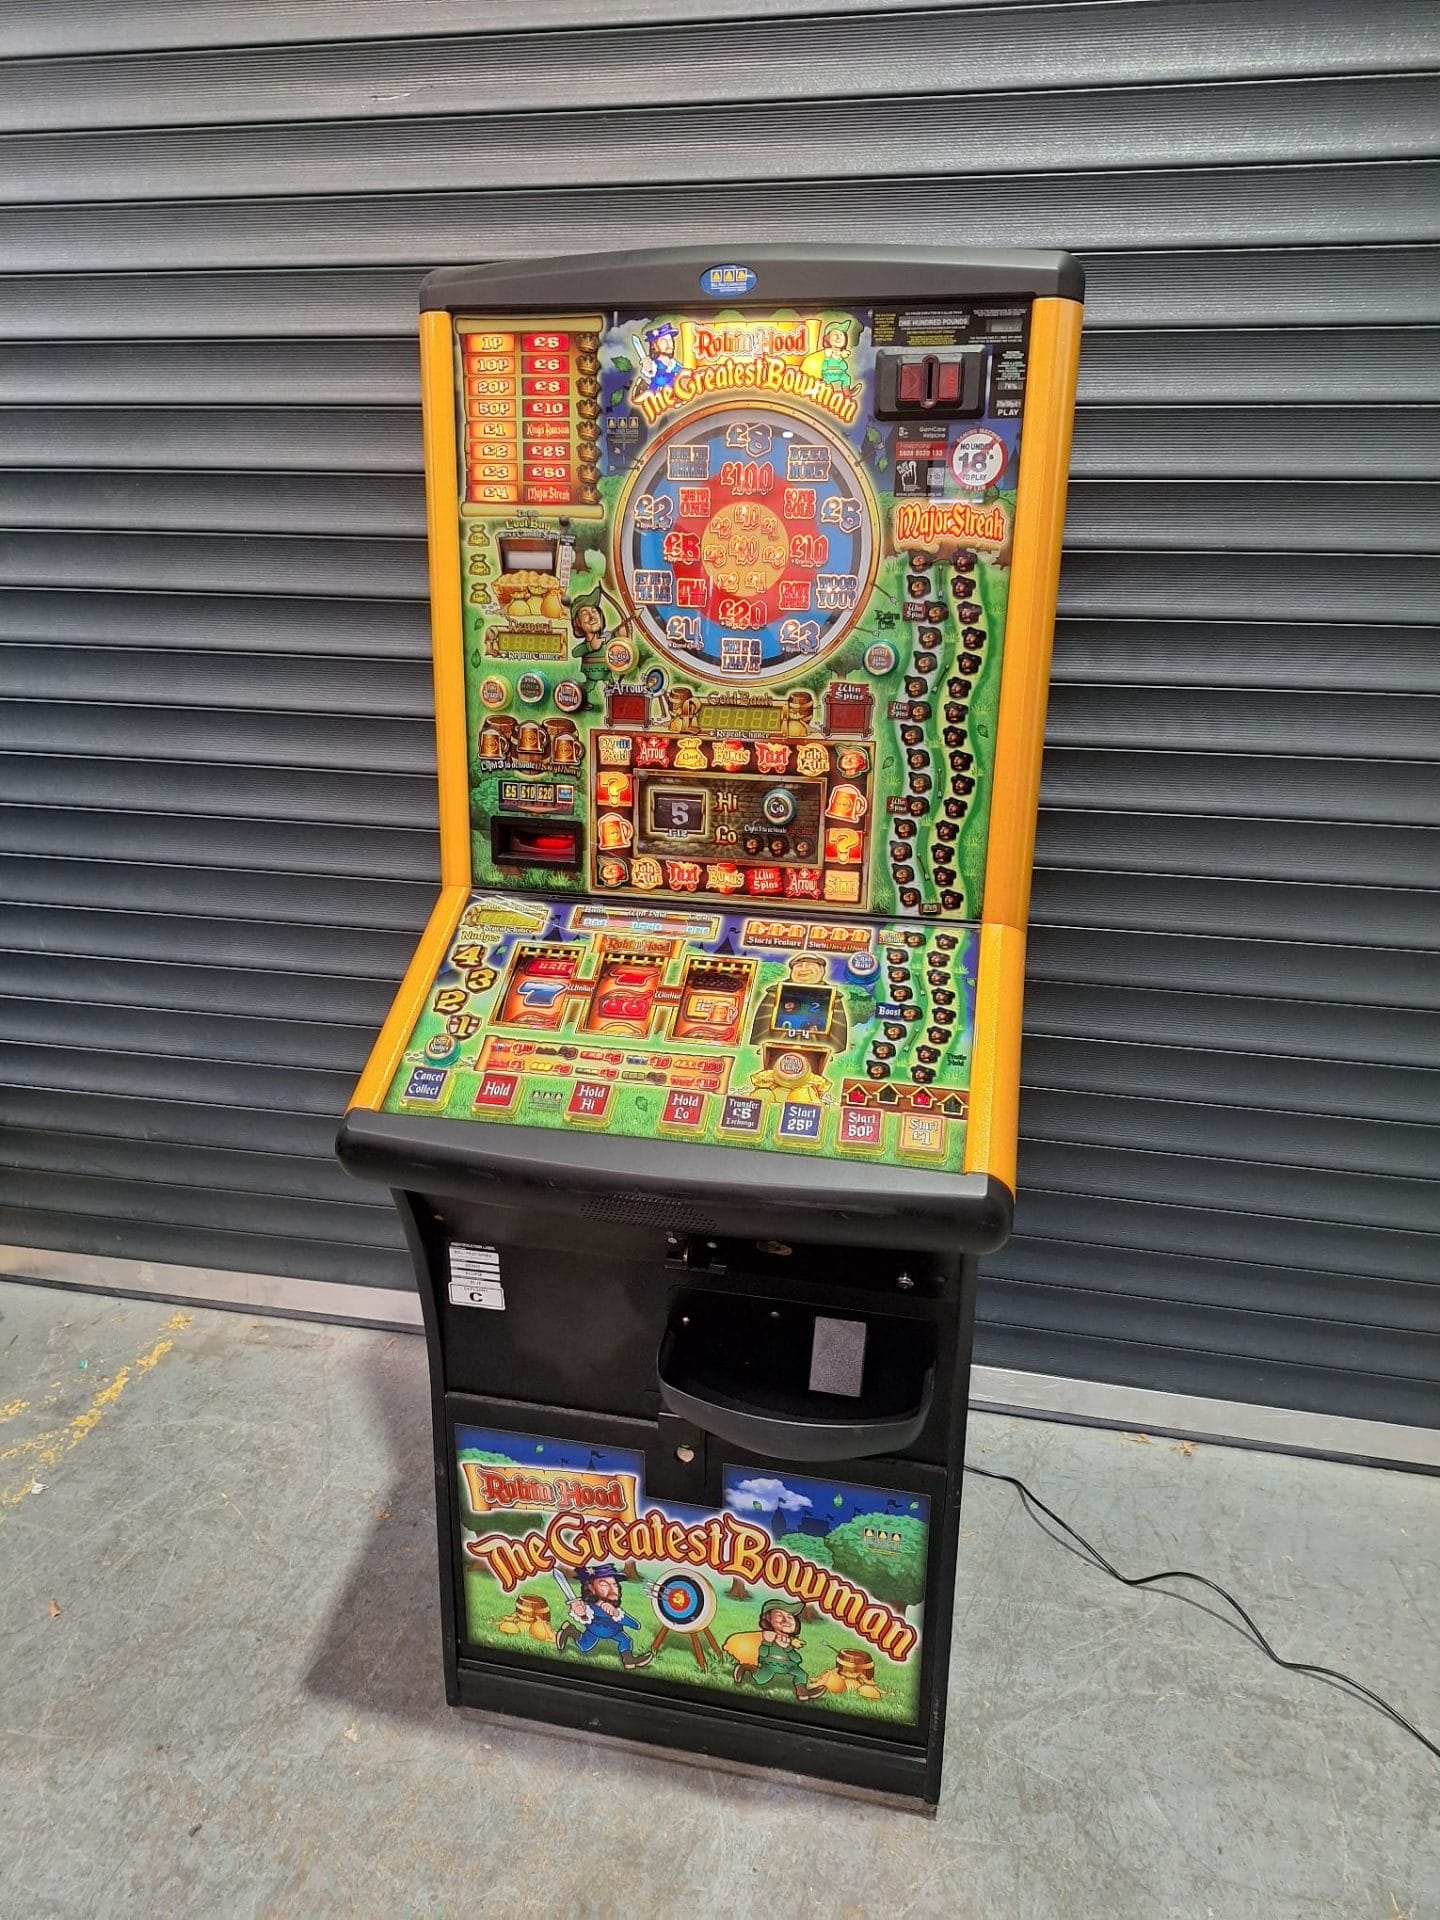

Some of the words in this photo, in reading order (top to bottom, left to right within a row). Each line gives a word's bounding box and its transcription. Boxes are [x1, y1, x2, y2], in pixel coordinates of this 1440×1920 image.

[695, 329, 748, 356] Robin
[751, 328, 806, 356] Hood
[631, 388, 673, 424] The
[674, 356, 765, 401] Greatest
[764, 355, 858, 423] Bowman
[532, 402, 563, 414] £10
[998, 408, 1019, 416] PLAY
[484, 423, 505, 436] £1
[727, 423, 772, 457] £8
[970, 442, 993, 450] UNDER
[483, 445, 508, 458] £2
[532, 446, 565, 457] £25
[483, 466, 508, 478] £3
[532, 467, 565, 478] £50
[721, 461, 774, 494] £100
[484, 486, 509, 500] £4
[634, 494, 673, 528] £2
[898, 504, 951, 543] Major
[951, 503, 1005, 542] Streak
[790, 534, 828, 567] £10
[719, 598, 767, 630] £20
[780, 619, 820, 654] £3
[611, 681, 648, 694] Arrows
[838, 684, 862, 693] Win
[835, 691, 864, 700] Spins
[641, 743, 664, 760] Arrow
[498, 760, 504, 769] 3
[505, 785, 516, 798] £5
[522, 786, 535, 799] £10
[539, 787, 552, 800] £20
[716, 791, 737, 812] Hi
[671, 802, 689, 825] 5
[770, 803, 785, 814] Go
[715, 826, 737, 845] Lo
[754, 869, 774, 881] Win
[753, 880, 778, 890] Spins
[790, 875, 817, 892] Arrow
[747, 935, 772, 945] Starts
[774, 938, 802, 947] Feature
[452, 946, 483, 968] 4
[467, 968, 497, 992] 3
[517, 981, 567, 1007] 7
[435, 989, 467, 1014] 2
[878, 1006, 901, 1016] Boost
[414, 1070, 443, 1081] Cancel
[408, 1083, 439, 1095] Collect
[483, 1082, 510, 1096] Hold
[578, 1085, 605, 1098] Hold
[579, 1098, 595, 1111] Hi
[672, 1094, 699, 1107] Hold
[728, 1098, 759, 1110] Transfer
[674, 1107, 689, 1119] Lo
[733, 1108, 751, 1119] £5
[788, 1105, 816, 1118] Start
[848, 1112, 877, 1124] Start
[909, 1118, 938, 1131] Start
[912, 1131, 931, 1145] £1
[469, 1291, 483, 1302] C
[478, 1469, 552, 1504] Robin
[556, 1479, 626, 1510] Hood
[468, 1532, 556, 1592] The
[546, 1509, 727, 1568] Greatest
[720, 1513, 917, 1662] Bowman
